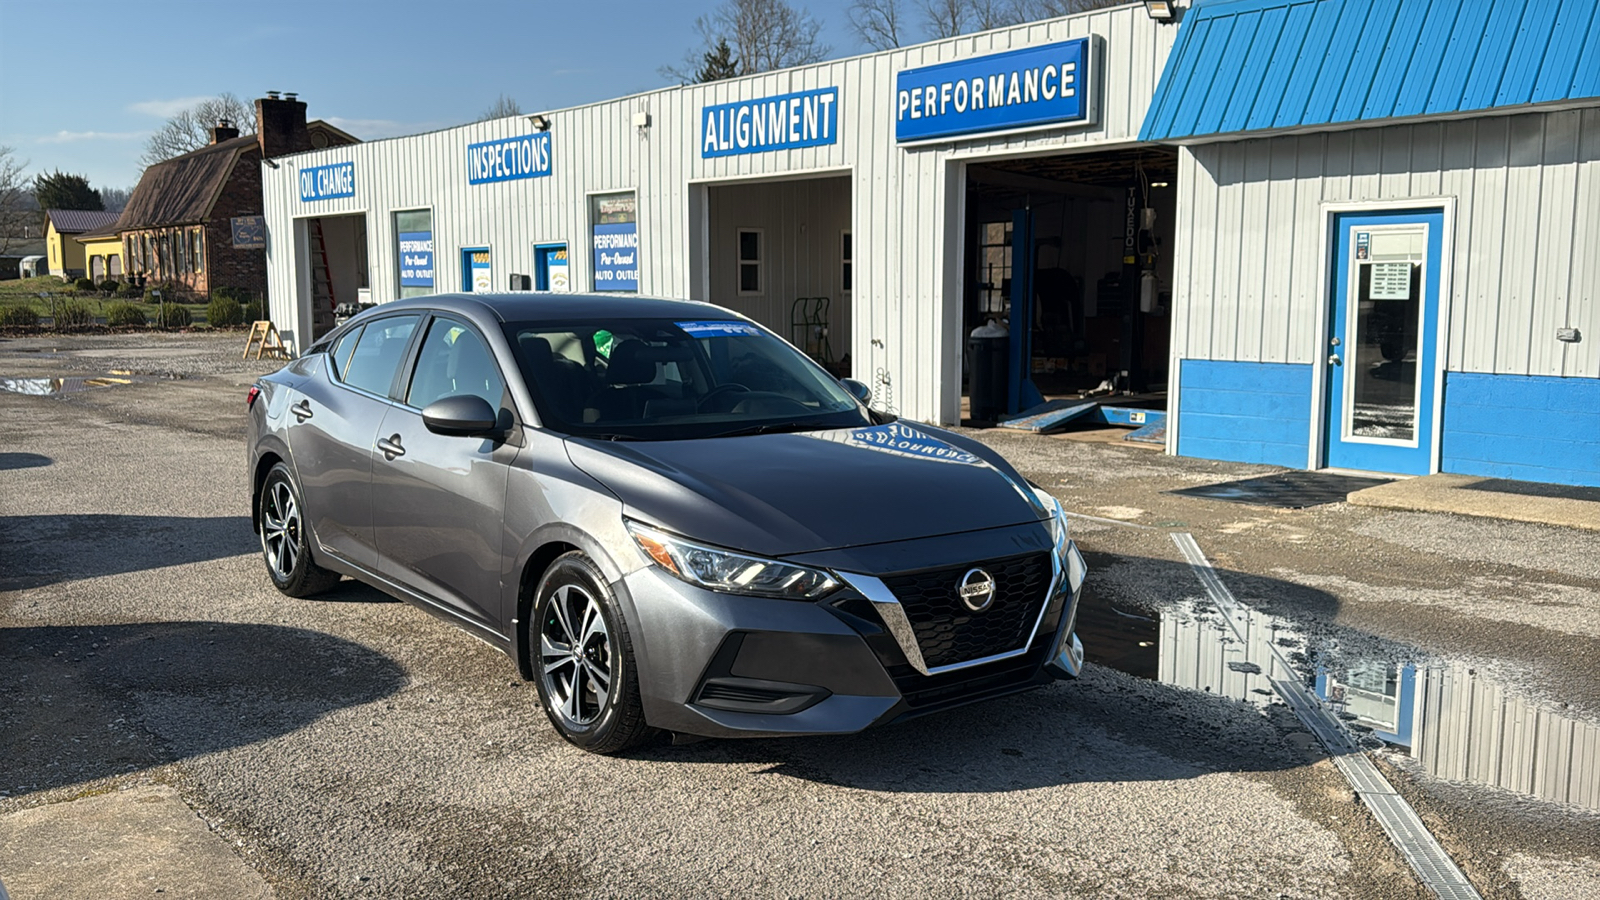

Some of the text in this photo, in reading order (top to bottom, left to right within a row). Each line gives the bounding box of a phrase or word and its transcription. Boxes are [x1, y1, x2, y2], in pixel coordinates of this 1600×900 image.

[898, 62, 1076, 121] PERFORMANCE
[704, 93, 835, 152] ALIGNMENT
[469, 136, 549, 181] INSPECTIONS
[301, 165, 353, 198] OIL CHANGE
[1125, 187, 1136, 247] TUXEDO
[400, 240, 433, 253] PERFORMANCE
[594, 233, 638, 249] PERFORMANC
[402, 270, 434, 278] AUTO OUTLET
[595, 269, 639, 280] AUTO OUTLE
[962, 583, 992, 595] NISSAN
